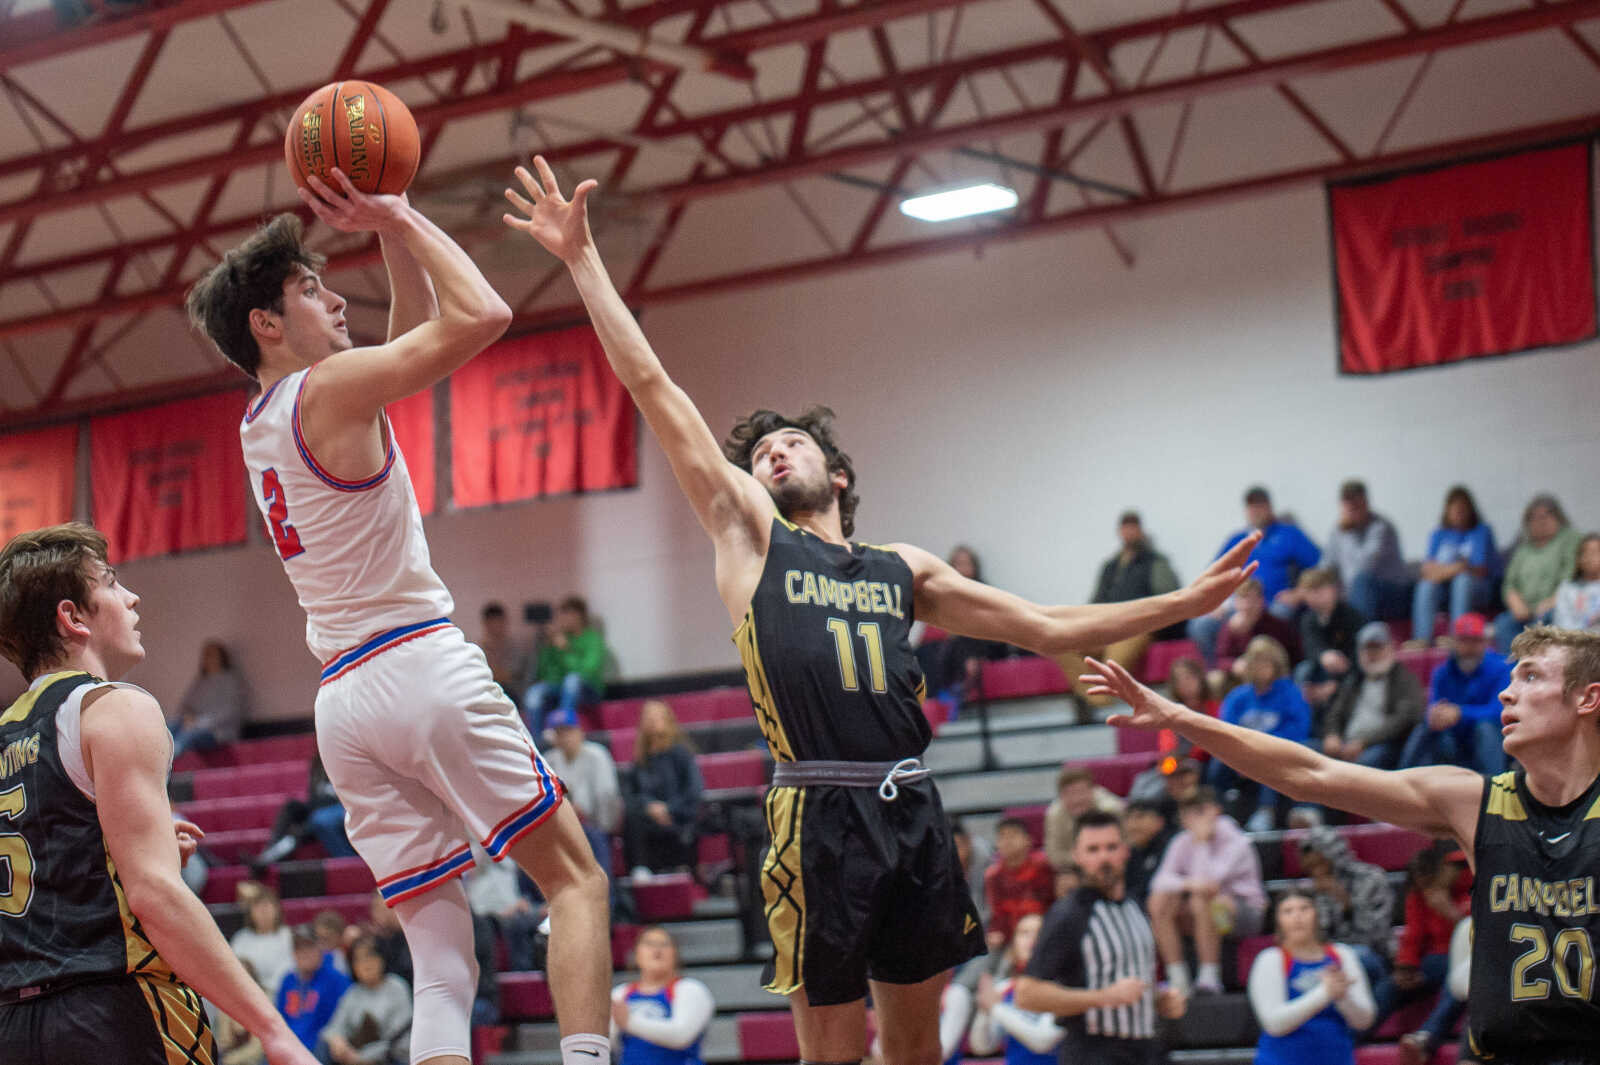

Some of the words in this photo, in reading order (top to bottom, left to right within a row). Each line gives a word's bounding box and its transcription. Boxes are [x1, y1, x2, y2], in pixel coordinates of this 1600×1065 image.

[310, 103, 329, 178] LEGACY
[343, 94, 370, 182] SPALDING
[261, 467, 306, 561] 2
[785, 569, 904, 620] CAMPBELL
[826, 617, 888, 693] 11
[1510, 922, 1597, 1002] 20
